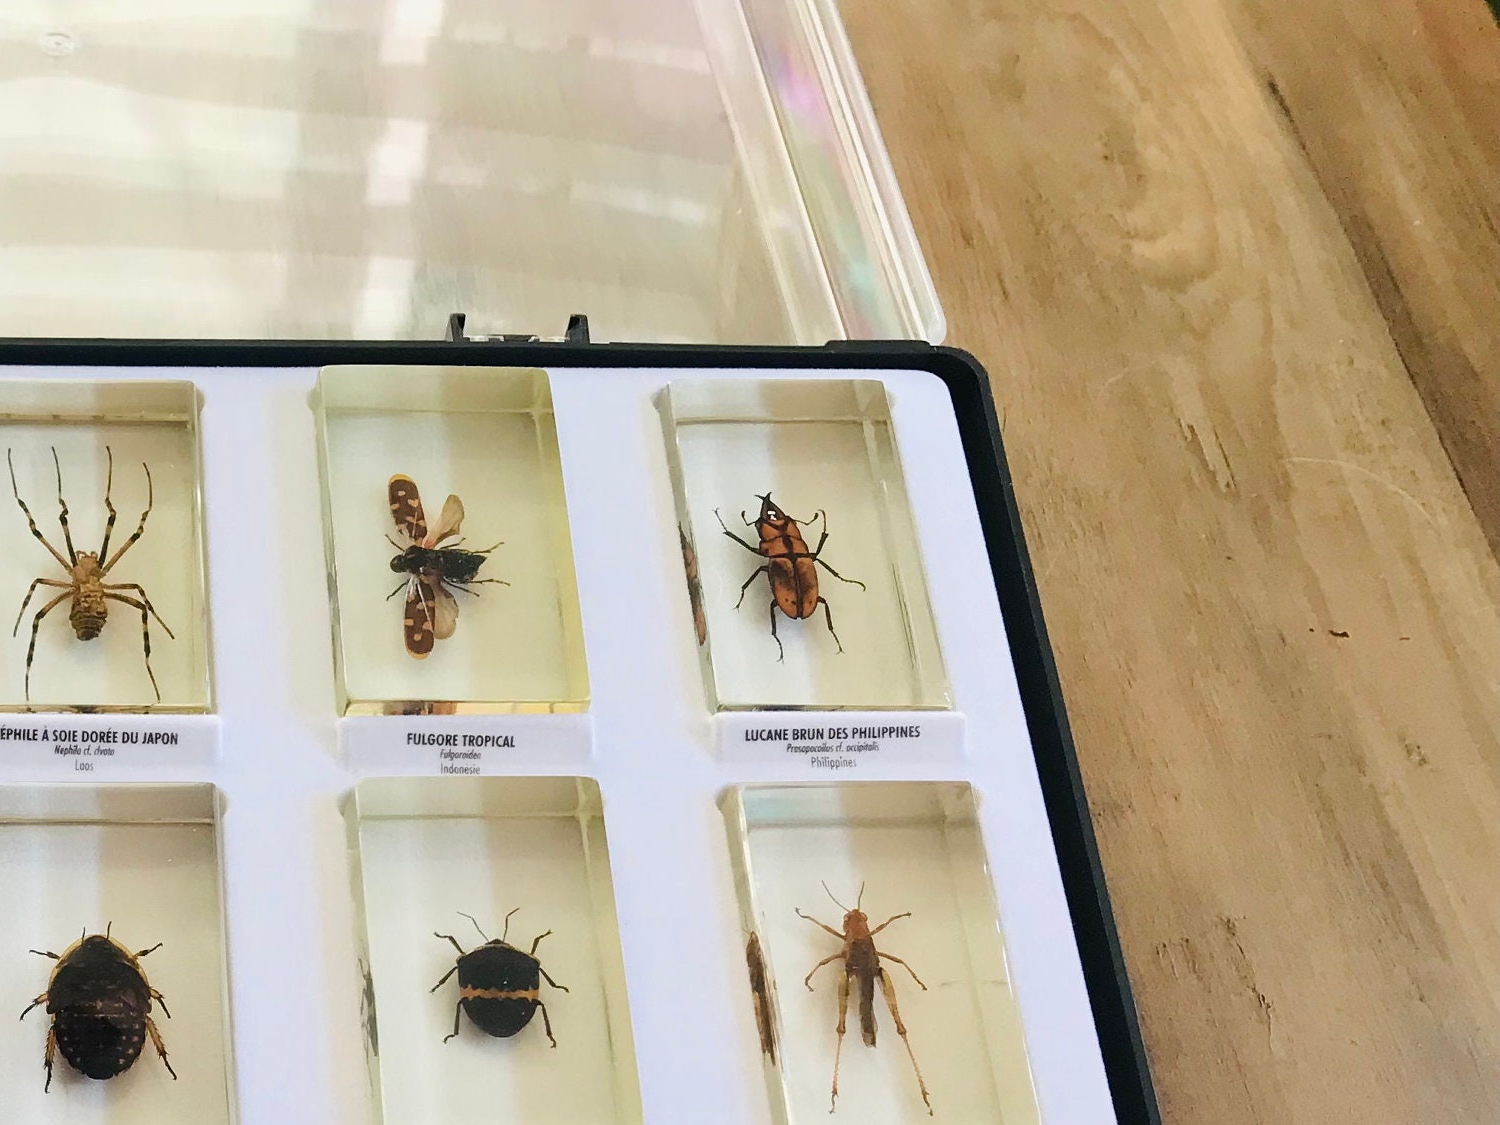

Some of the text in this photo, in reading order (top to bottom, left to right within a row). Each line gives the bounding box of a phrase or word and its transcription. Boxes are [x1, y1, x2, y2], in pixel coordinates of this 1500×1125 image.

[42, 725, 49, 741] À
[53, 729, 78, 742] SOIE
[82, 728, 118, 743] DORÉE
[121, 732, 138, 744] DU
[142, 733, 178, 745] JAPON
[407, 733, 515, 748] FULGORE TROPICAL
[745, 726, 920, 741] LUCANE BRUN DES PHILIPPINES
[54, 745, 81, 756] Nephila
[75, 759, 93, 771] Laos
[811, 757, 857, 770] Philippines
